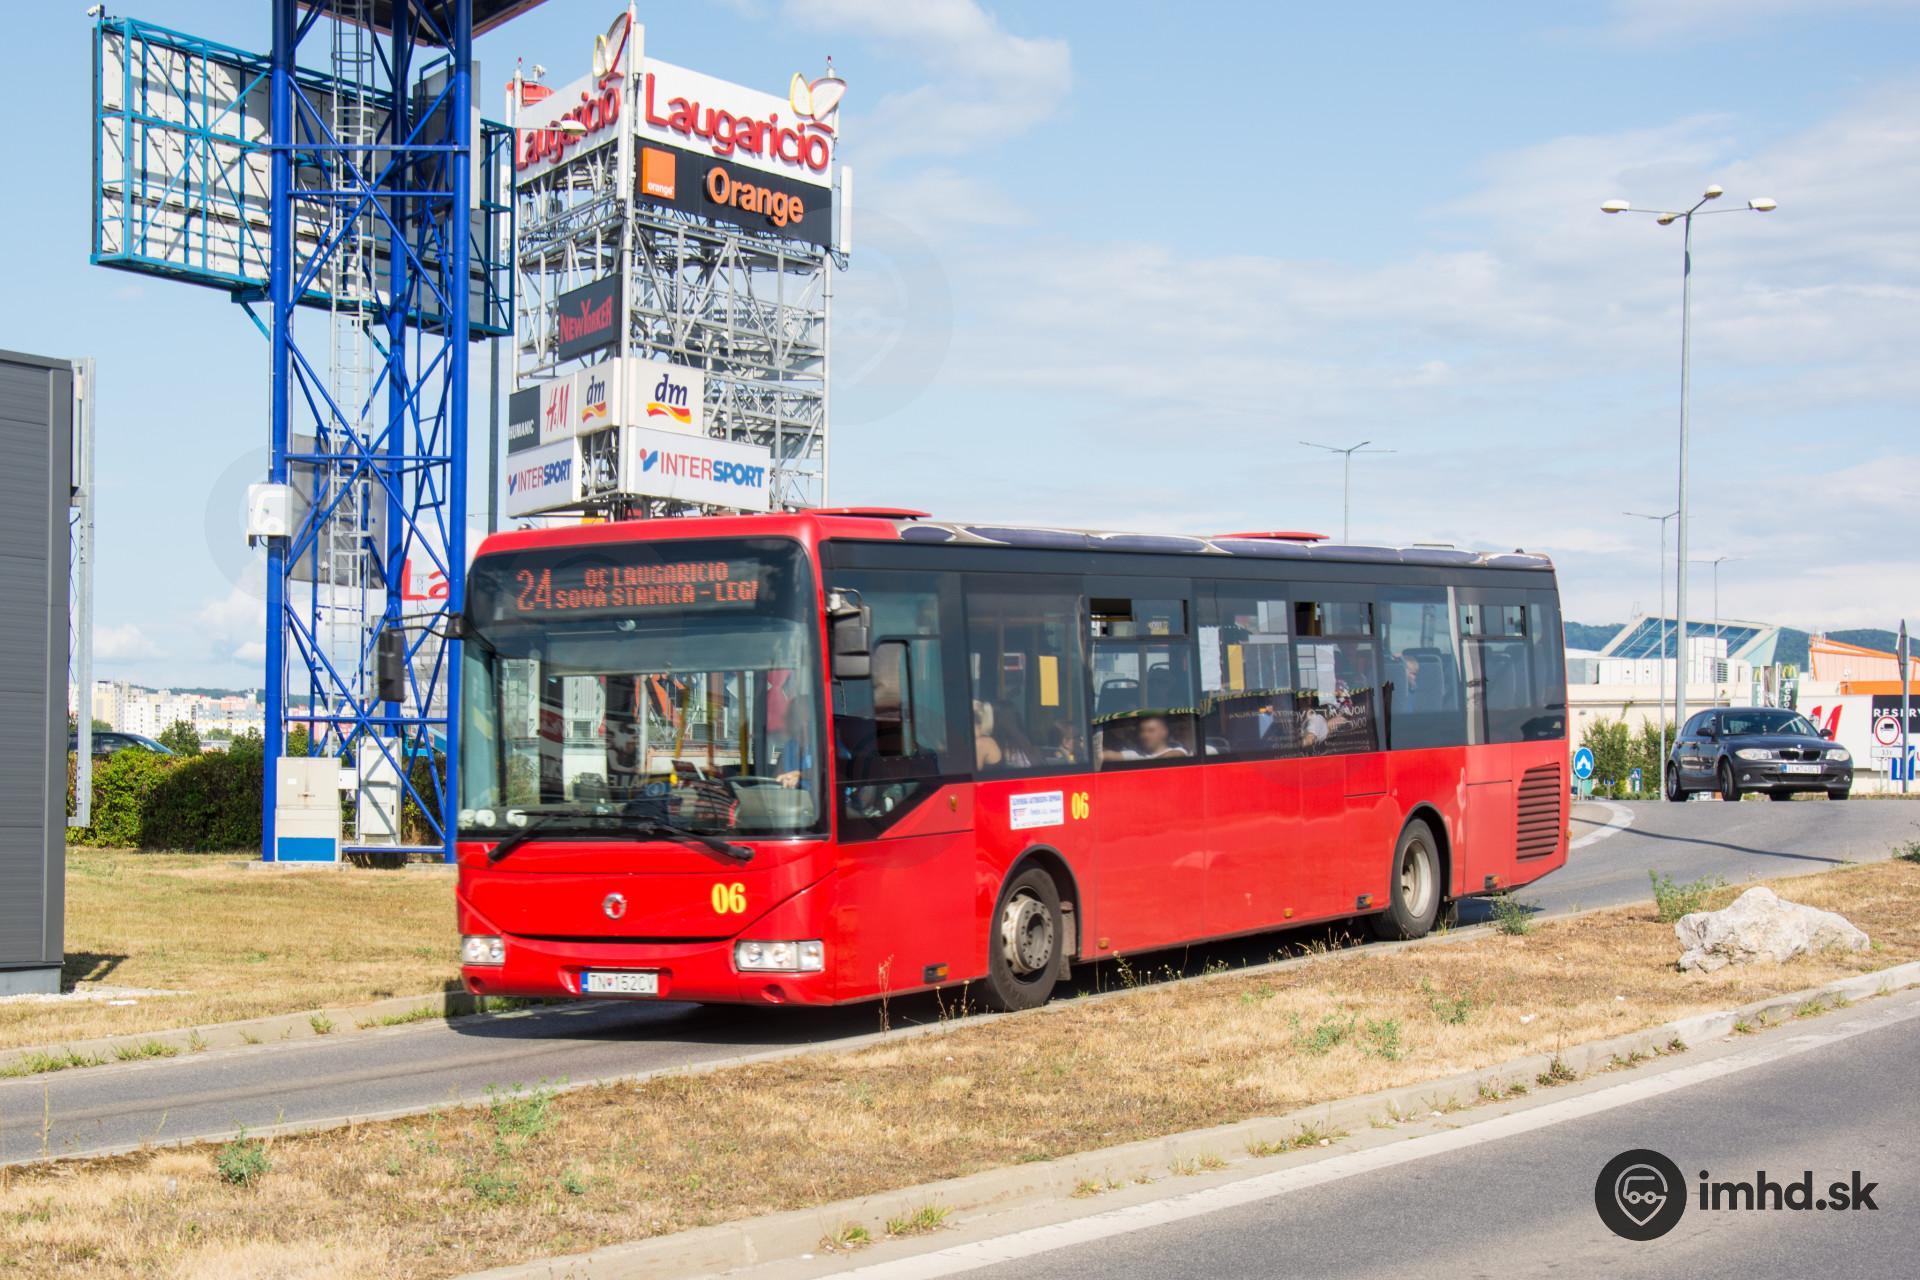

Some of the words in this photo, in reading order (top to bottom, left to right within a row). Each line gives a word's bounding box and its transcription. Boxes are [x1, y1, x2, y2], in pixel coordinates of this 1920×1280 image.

[645, 73, 833, 171] Laugaricio
[706, 166, 804, 227] Orange
[586, 375, 605, 406] dm
[655, 373, 688, 406] dm
[518, 458, 572, 493] INTERSPORT
[661, 451, 765, 488] INTERSPORT
[516, 568, 552, 610] 24
[612, 562, 729, 586] LAUGARICIO
[610, 584, 696, 606] STANICA
[1071, 791, 1090, 820] 06
[711, 882, 747, 914] 06
